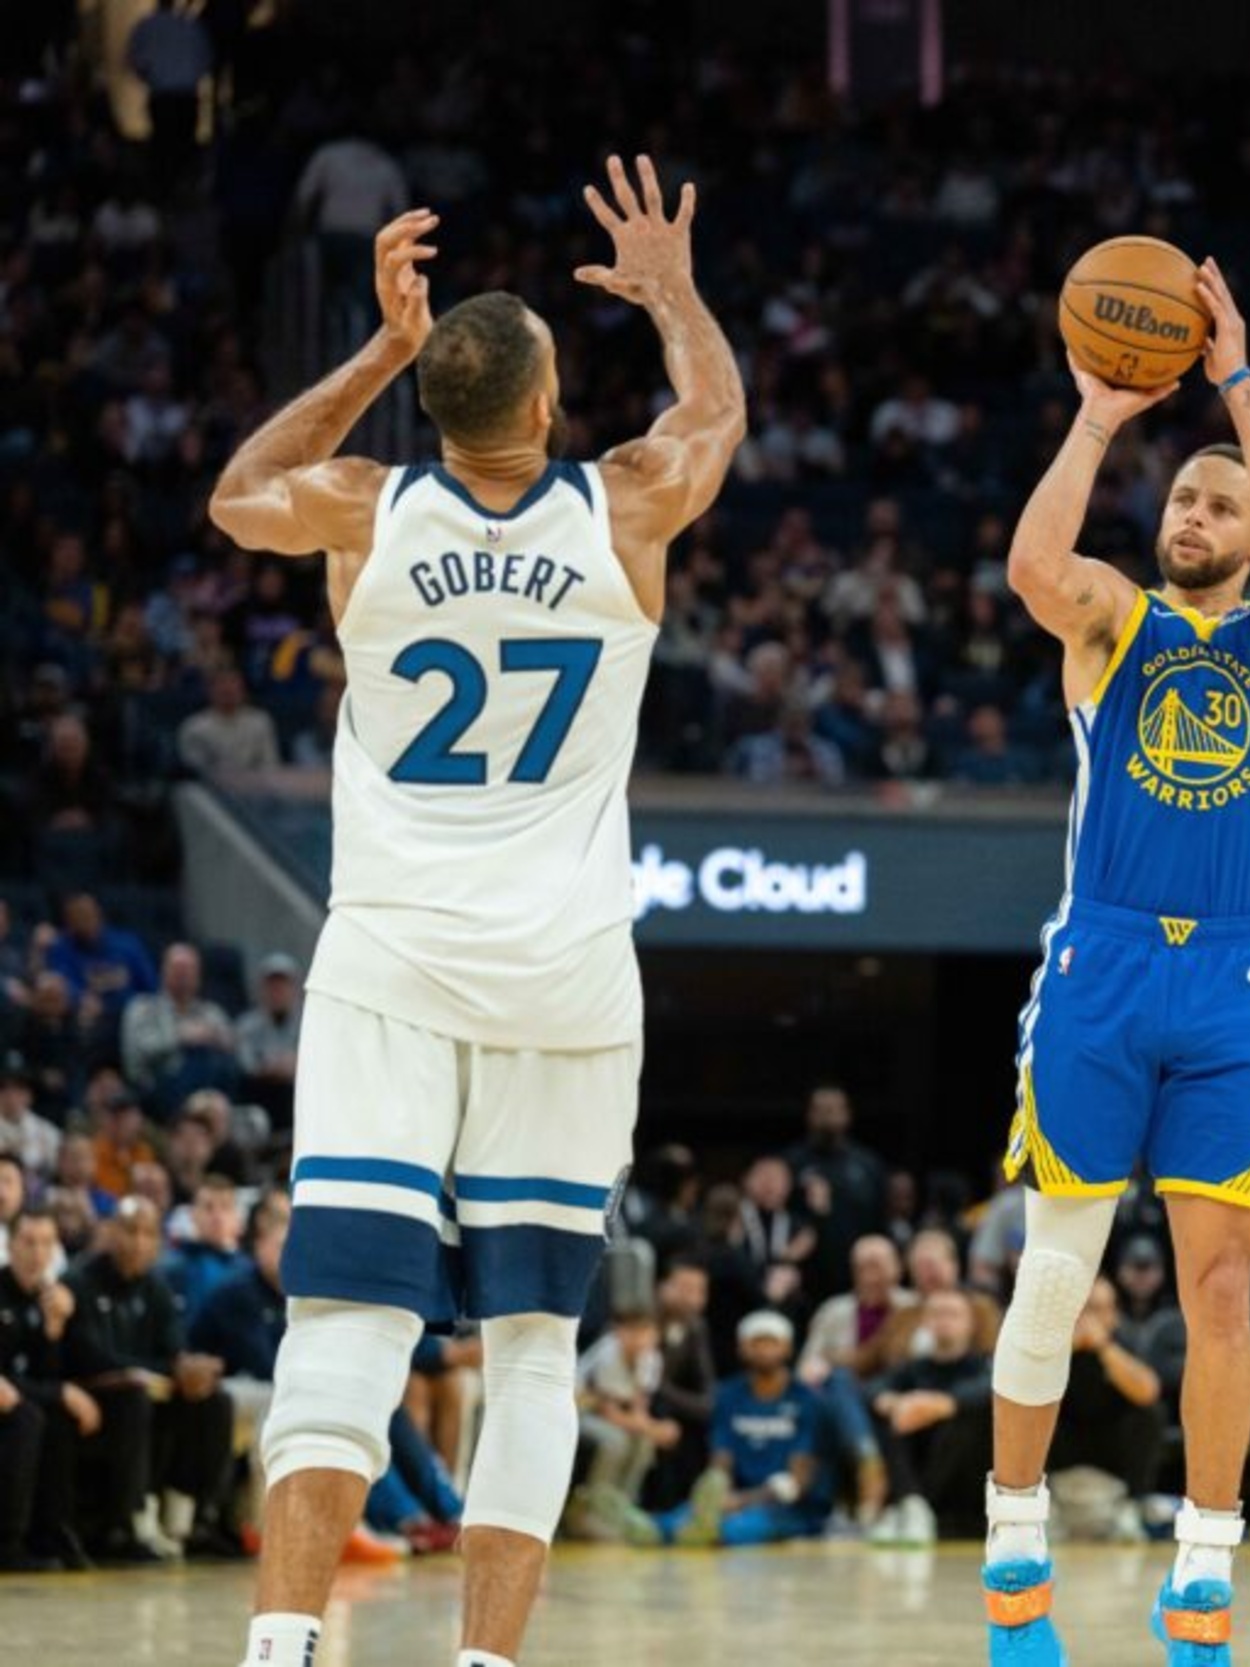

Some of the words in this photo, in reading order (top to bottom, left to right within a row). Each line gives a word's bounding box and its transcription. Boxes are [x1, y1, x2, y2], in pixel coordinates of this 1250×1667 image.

[1094, 293, 1190, 343] Wilson
[410, 551, 585, 610] GOBERT
[387, 637, 604, 785] 27
[1204, 690, 1242, 728] 30
[699, 848, 867, 913] Cloud
